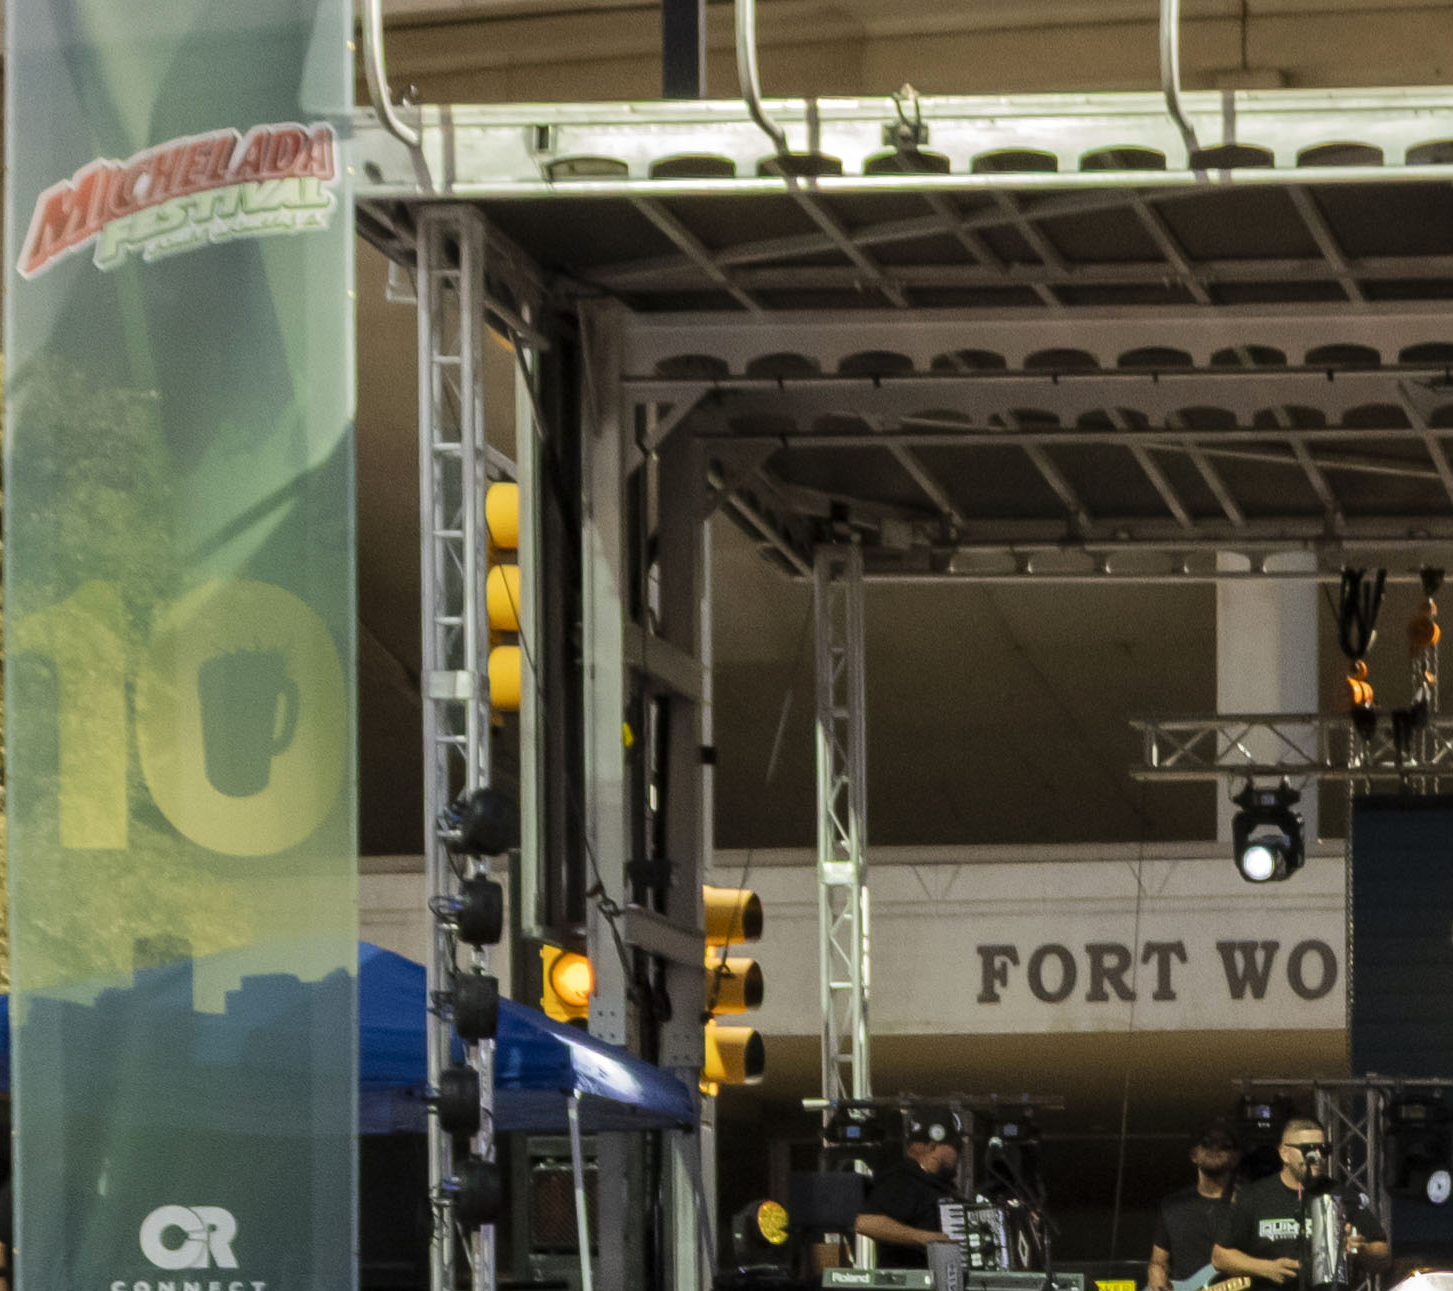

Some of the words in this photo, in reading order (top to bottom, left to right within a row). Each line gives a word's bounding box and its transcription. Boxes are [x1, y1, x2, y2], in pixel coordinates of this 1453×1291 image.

[22, 127, 335, 275] MICHELADA
[97, 178, 327, 266] FESTIVAL
[4, 579, 348, 857] 10
[977, 940, 1188, 1004] FORT
[139, 1204, 239, 1270] CR
